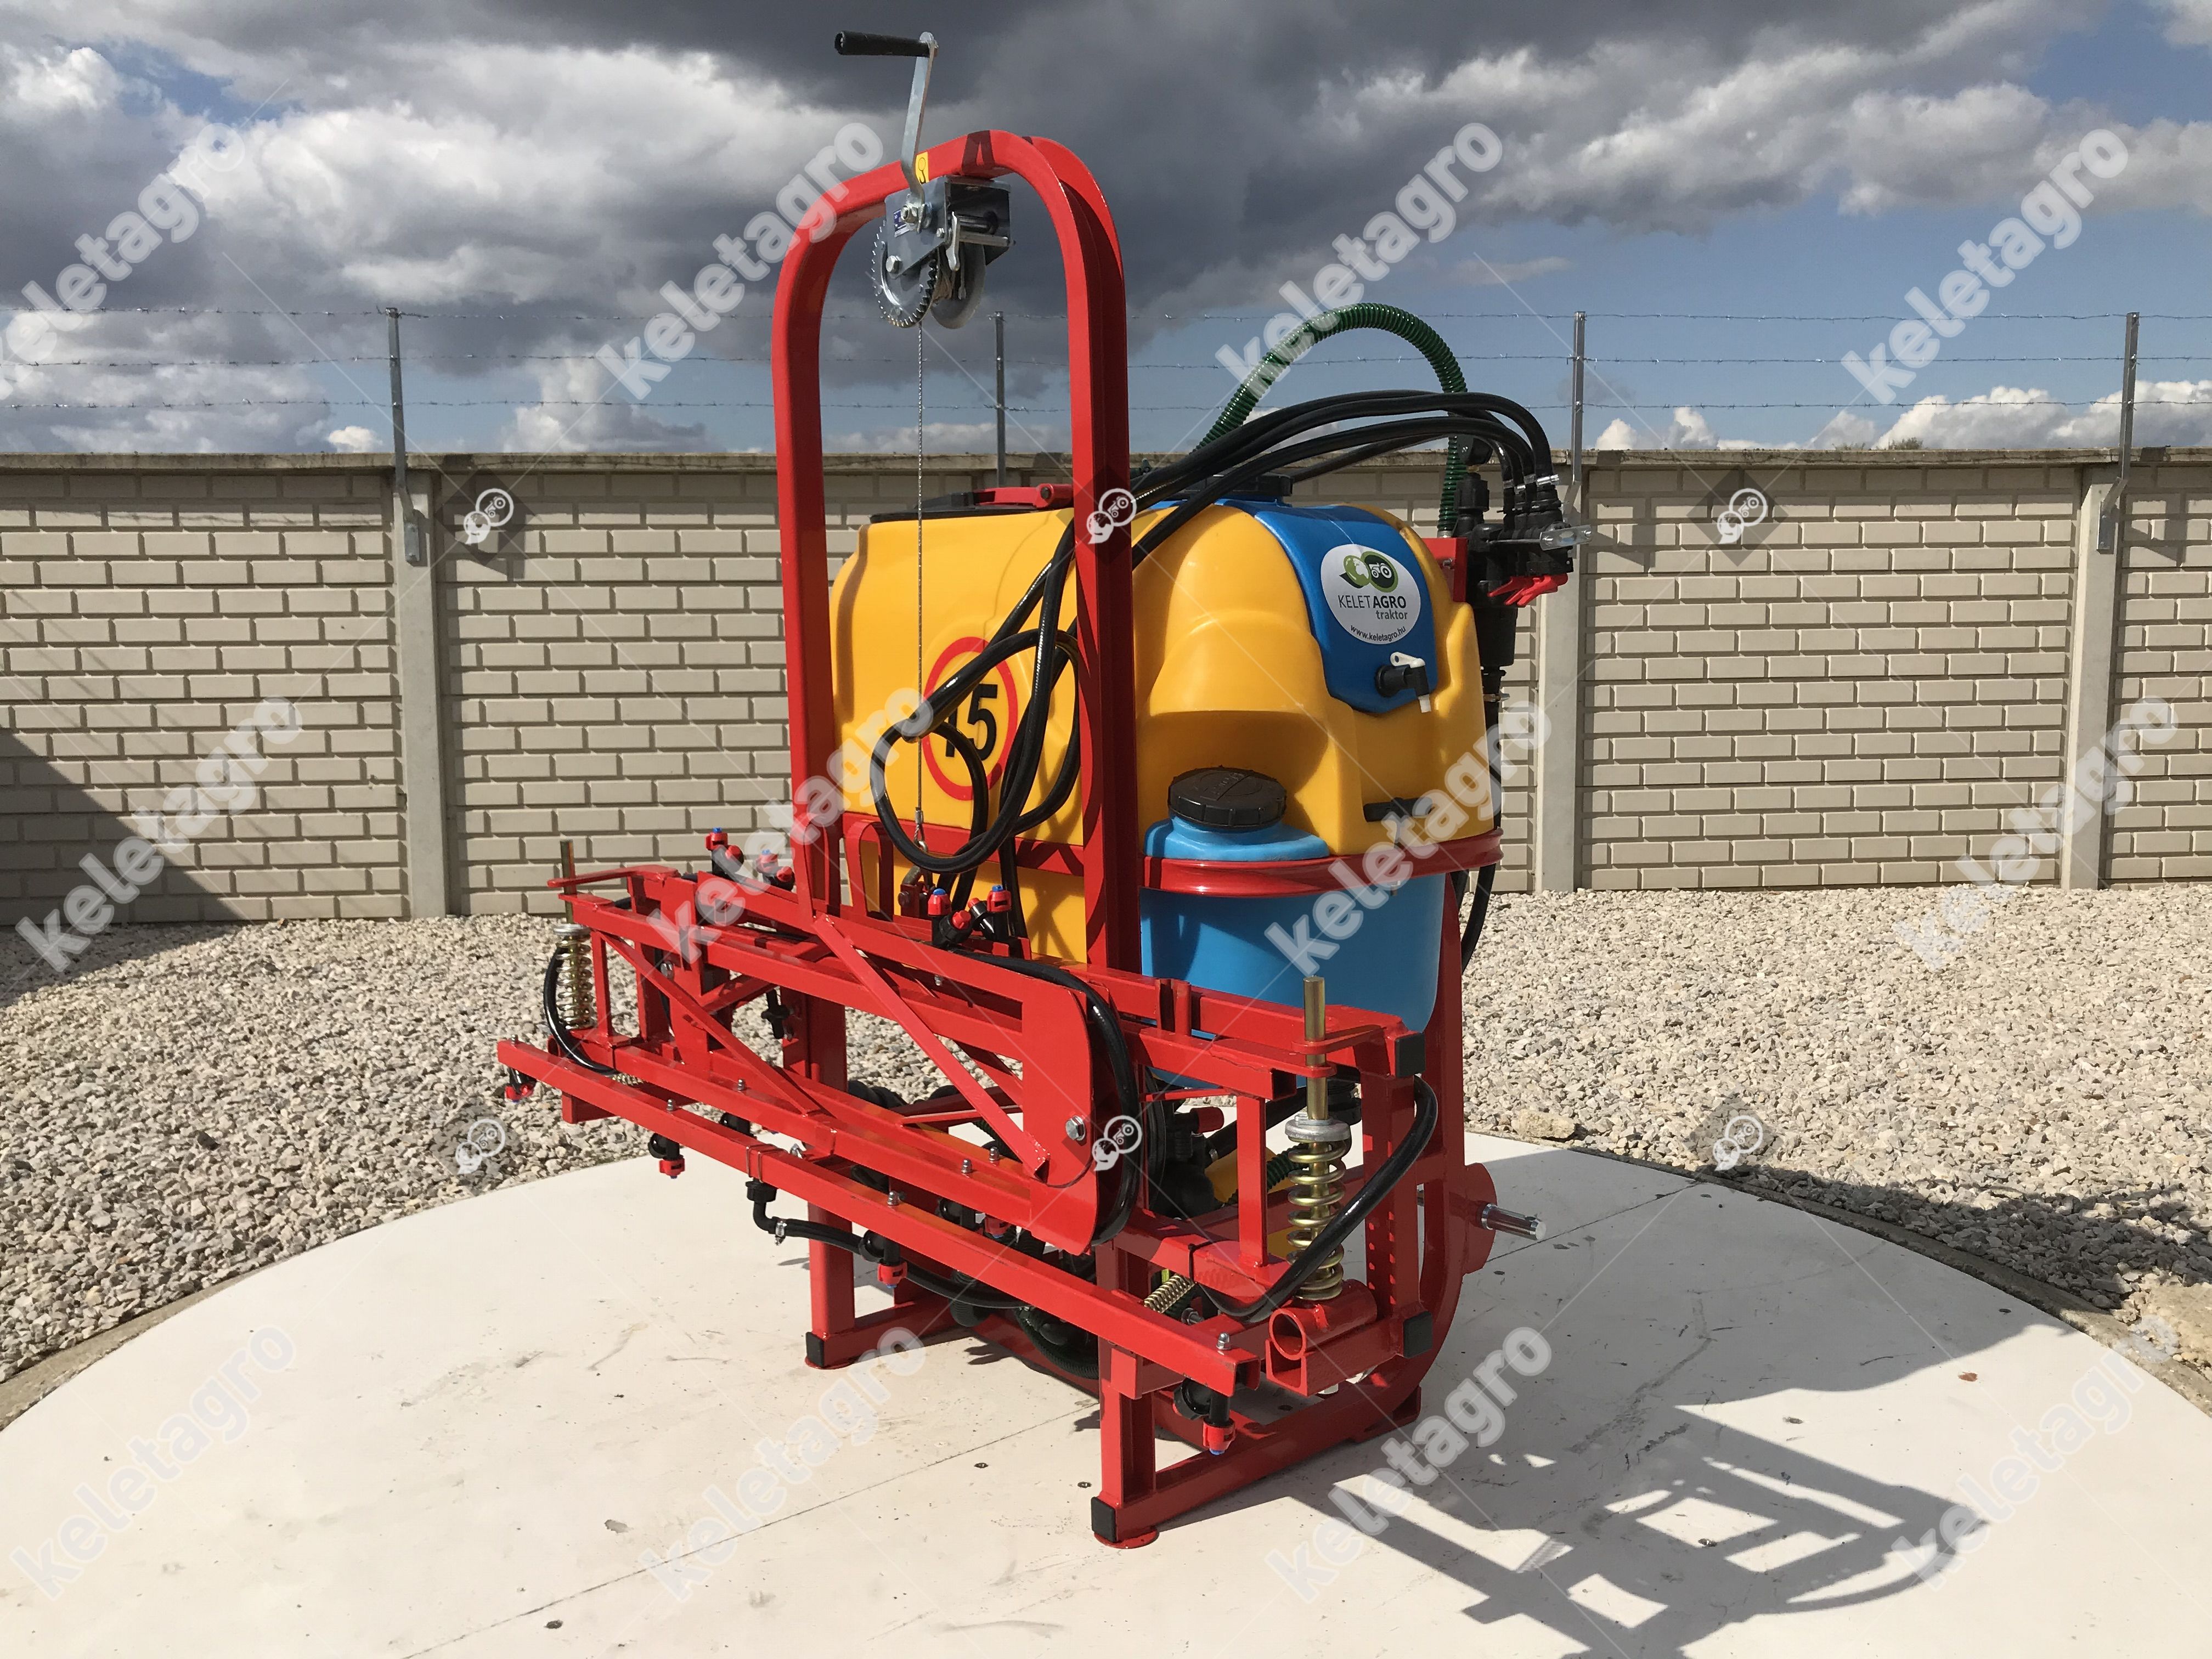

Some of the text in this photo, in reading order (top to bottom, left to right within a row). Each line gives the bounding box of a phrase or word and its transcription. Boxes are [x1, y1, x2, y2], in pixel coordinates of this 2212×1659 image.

[1338, 595, 1407, 609] KELETAGRO
[1376, 610, 1408, 620] traktor
[1350, 625, 1407, 642] www.keletagro.hu
